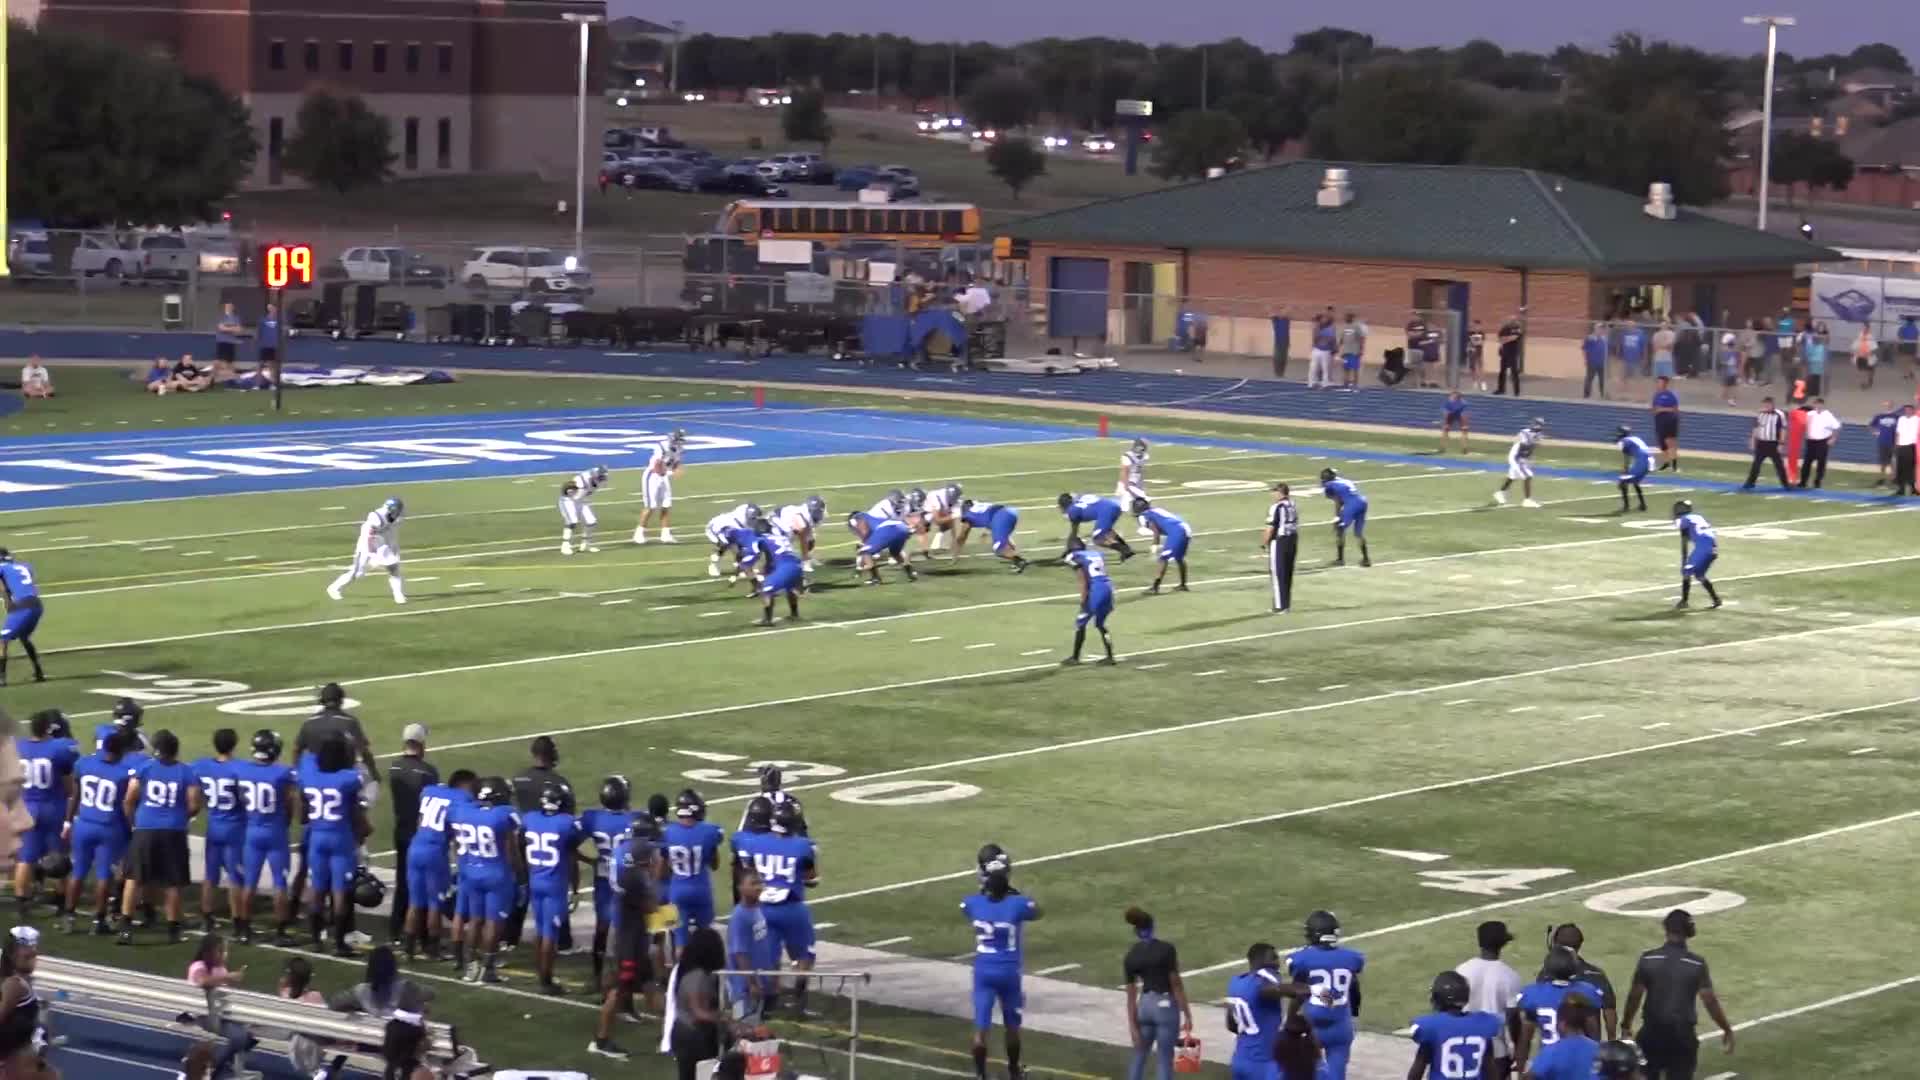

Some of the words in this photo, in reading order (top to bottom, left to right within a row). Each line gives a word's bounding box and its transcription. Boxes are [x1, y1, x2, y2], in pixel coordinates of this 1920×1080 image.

[267, 247, 311, 287] 09
[12, 565, 33, 585] 3
[80, 774, 117, 812] 60
[144, 780, 178, 807] 91
[199, 777, 235, 811] 35
[238, 780, 276, 813] 30
[303, 787, 343, 821] 32
[419, 796, 451, 832] 40
[525, 831, 560, 866] 25
[668, 845, 702, 876] 81
[753, 853, 797, 883] 44
[973, 919, 1016, 954] 27
[1309, 968, 1352, 1006] 29
[1440, 1035, 1486, 1079] 63
